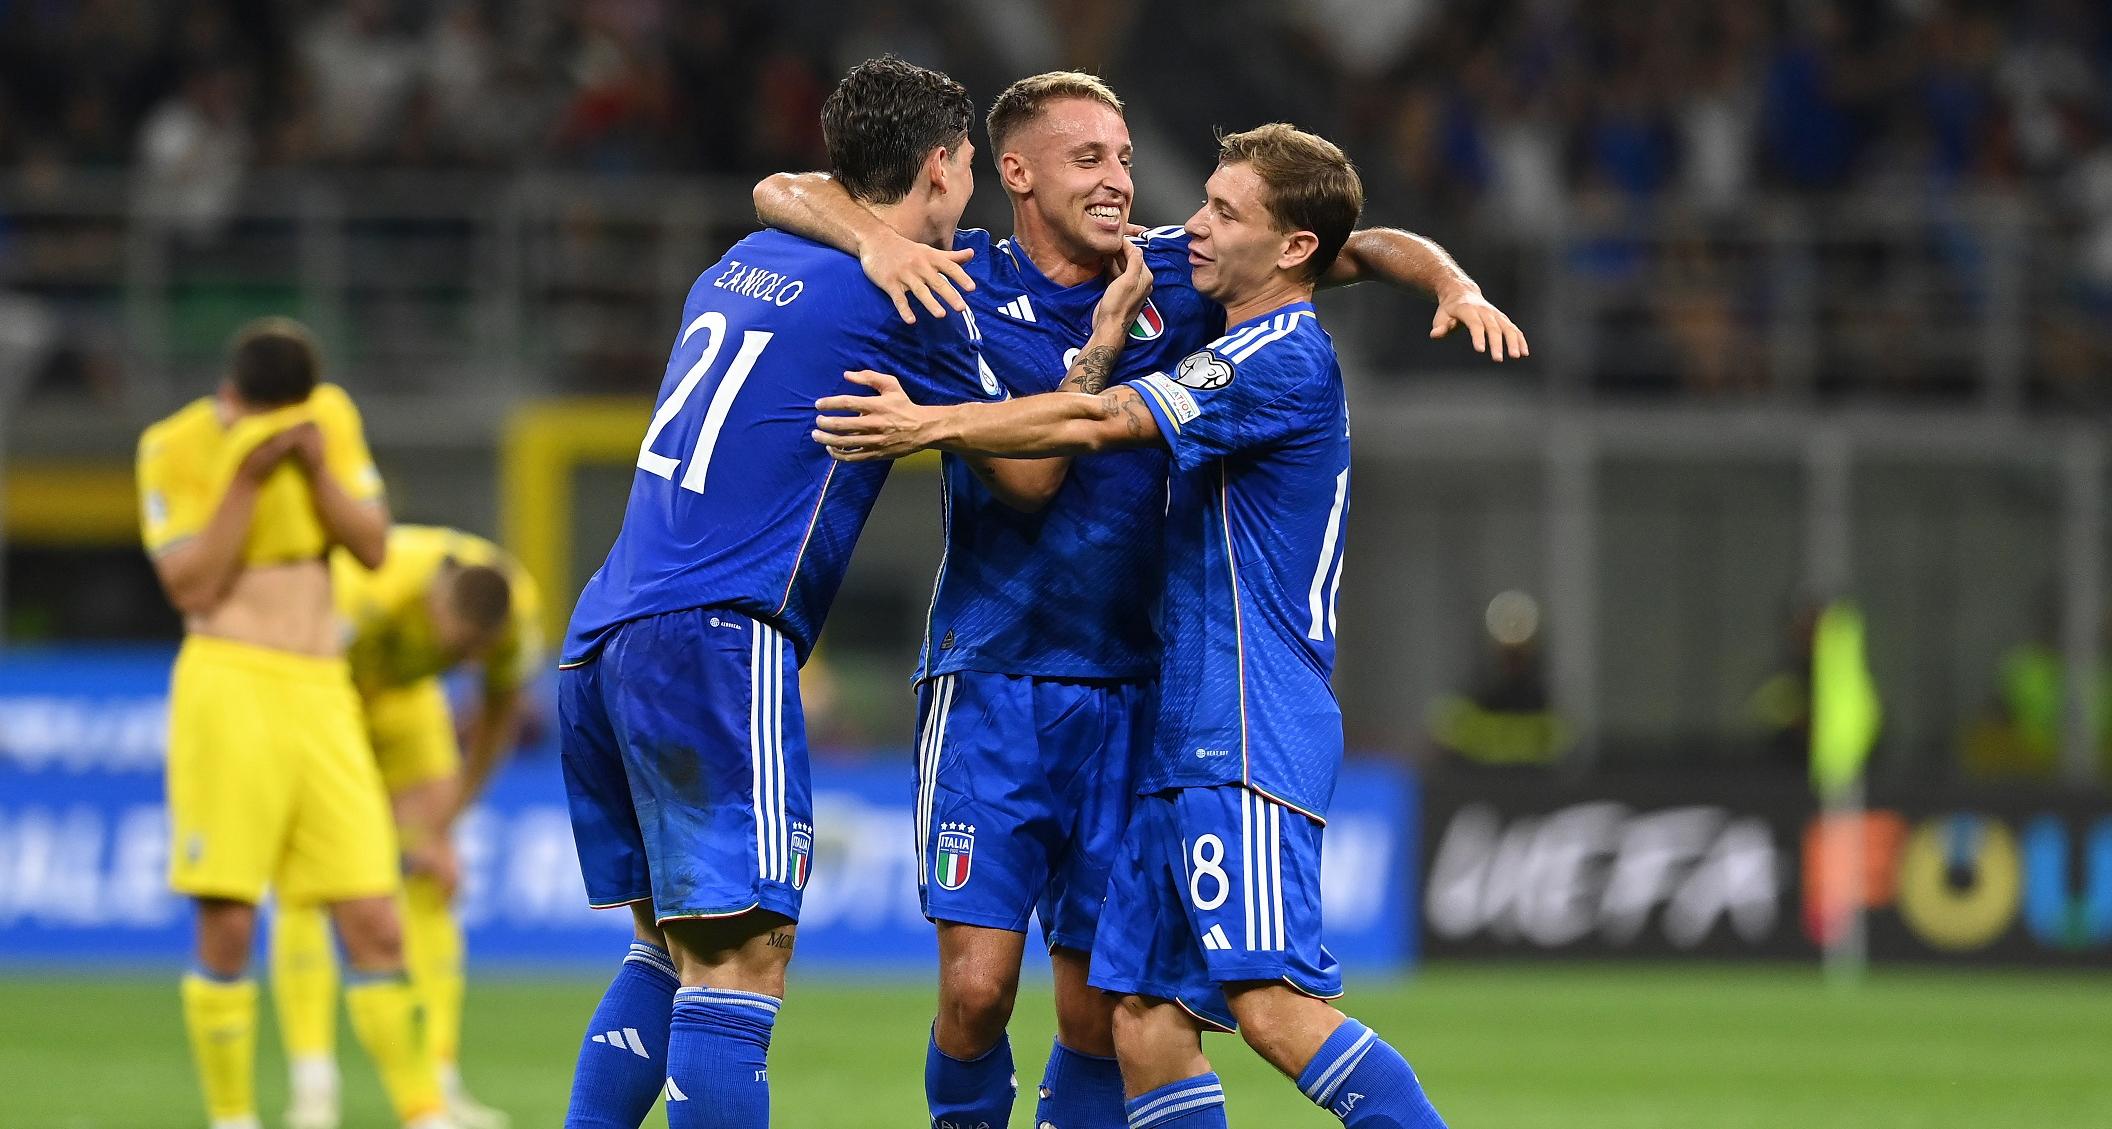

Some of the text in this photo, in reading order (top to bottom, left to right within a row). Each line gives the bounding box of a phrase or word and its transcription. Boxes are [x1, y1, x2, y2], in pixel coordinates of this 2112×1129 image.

[714, 260, 804, 307] ZANIOLO
[636, 311, 774, 495] 21
[1307, 466, 1349, 642] 1
[940, 836, 970, 850] ITALIA
[1182, 833, 1230, 912] 8
[1426, 801, 1780, 946] UEFA
[1334, 1092, 1365, 1118] LIA
